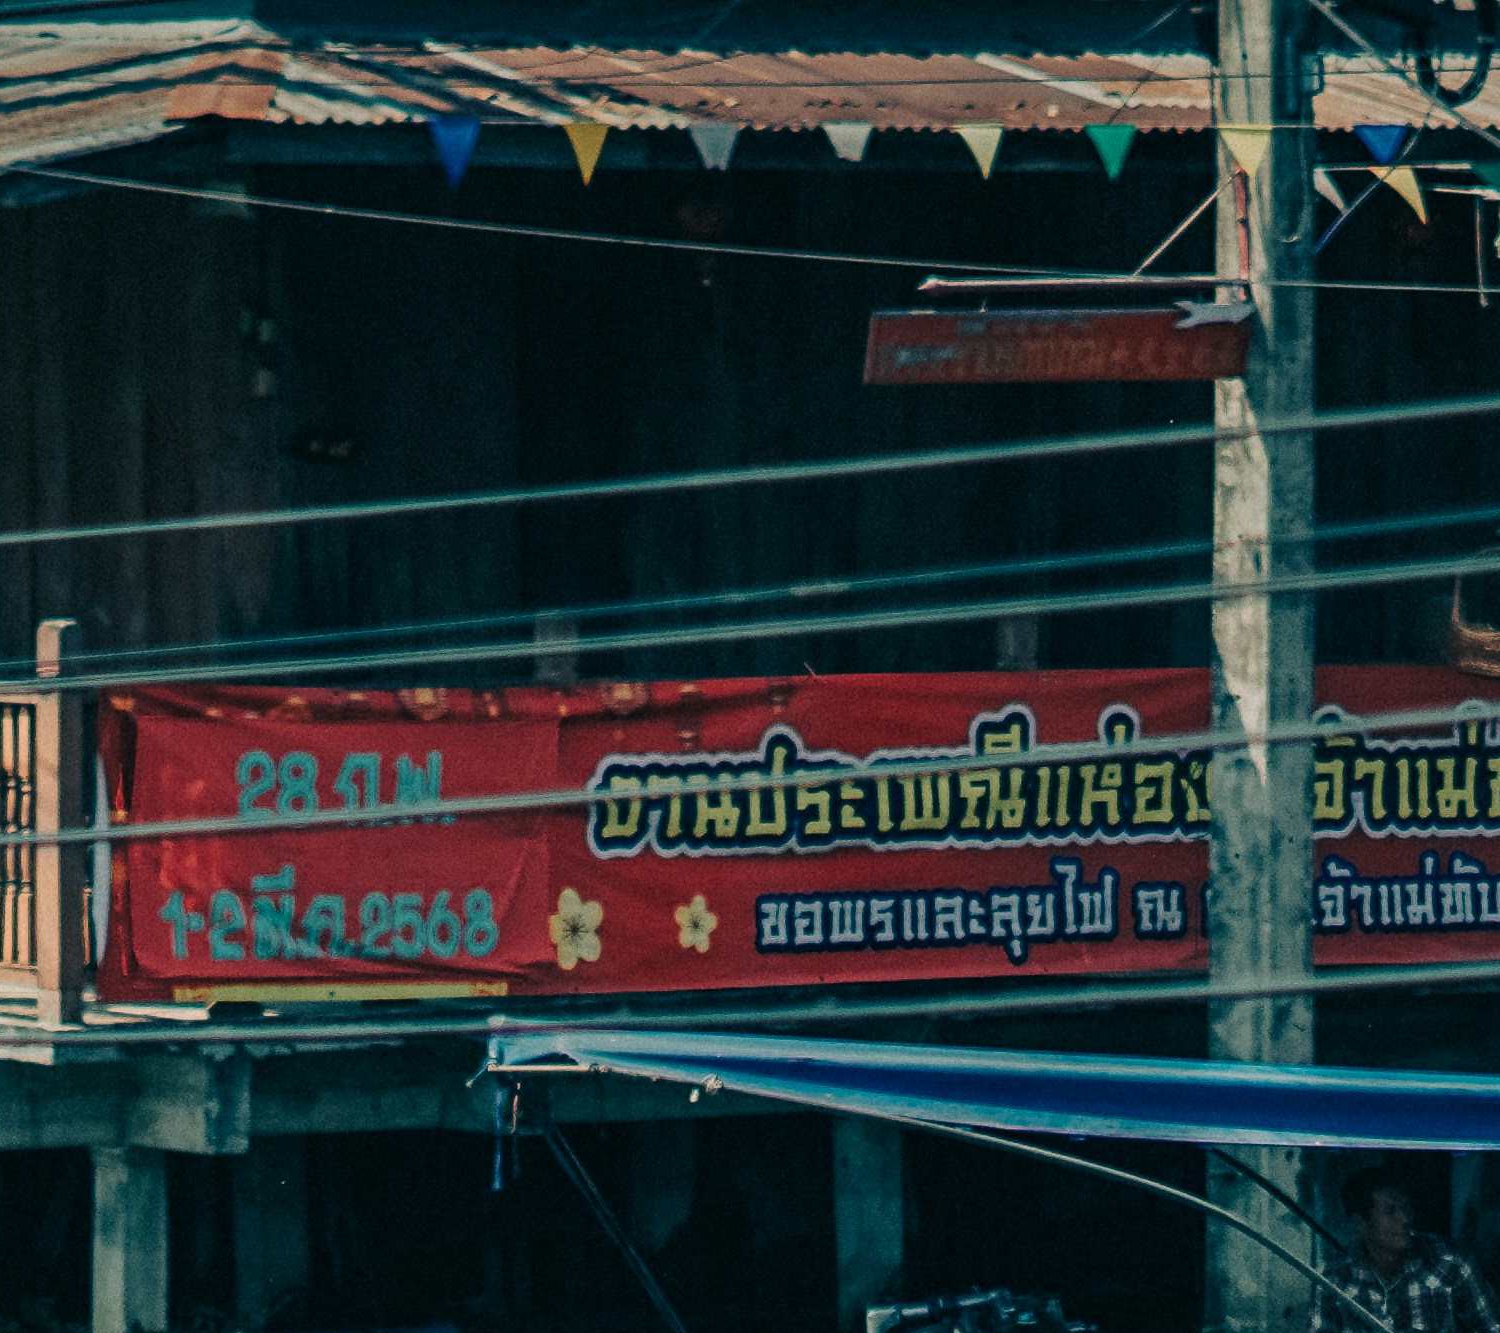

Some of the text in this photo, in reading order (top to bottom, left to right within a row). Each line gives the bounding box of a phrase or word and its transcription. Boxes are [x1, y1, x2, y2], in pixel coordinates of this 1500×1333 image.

[236, 749, 319, 824] 28
[758, 863, 1116, 958] ขอพรและลุยไฟ
[1135, 886, 1184, 933] ณ
